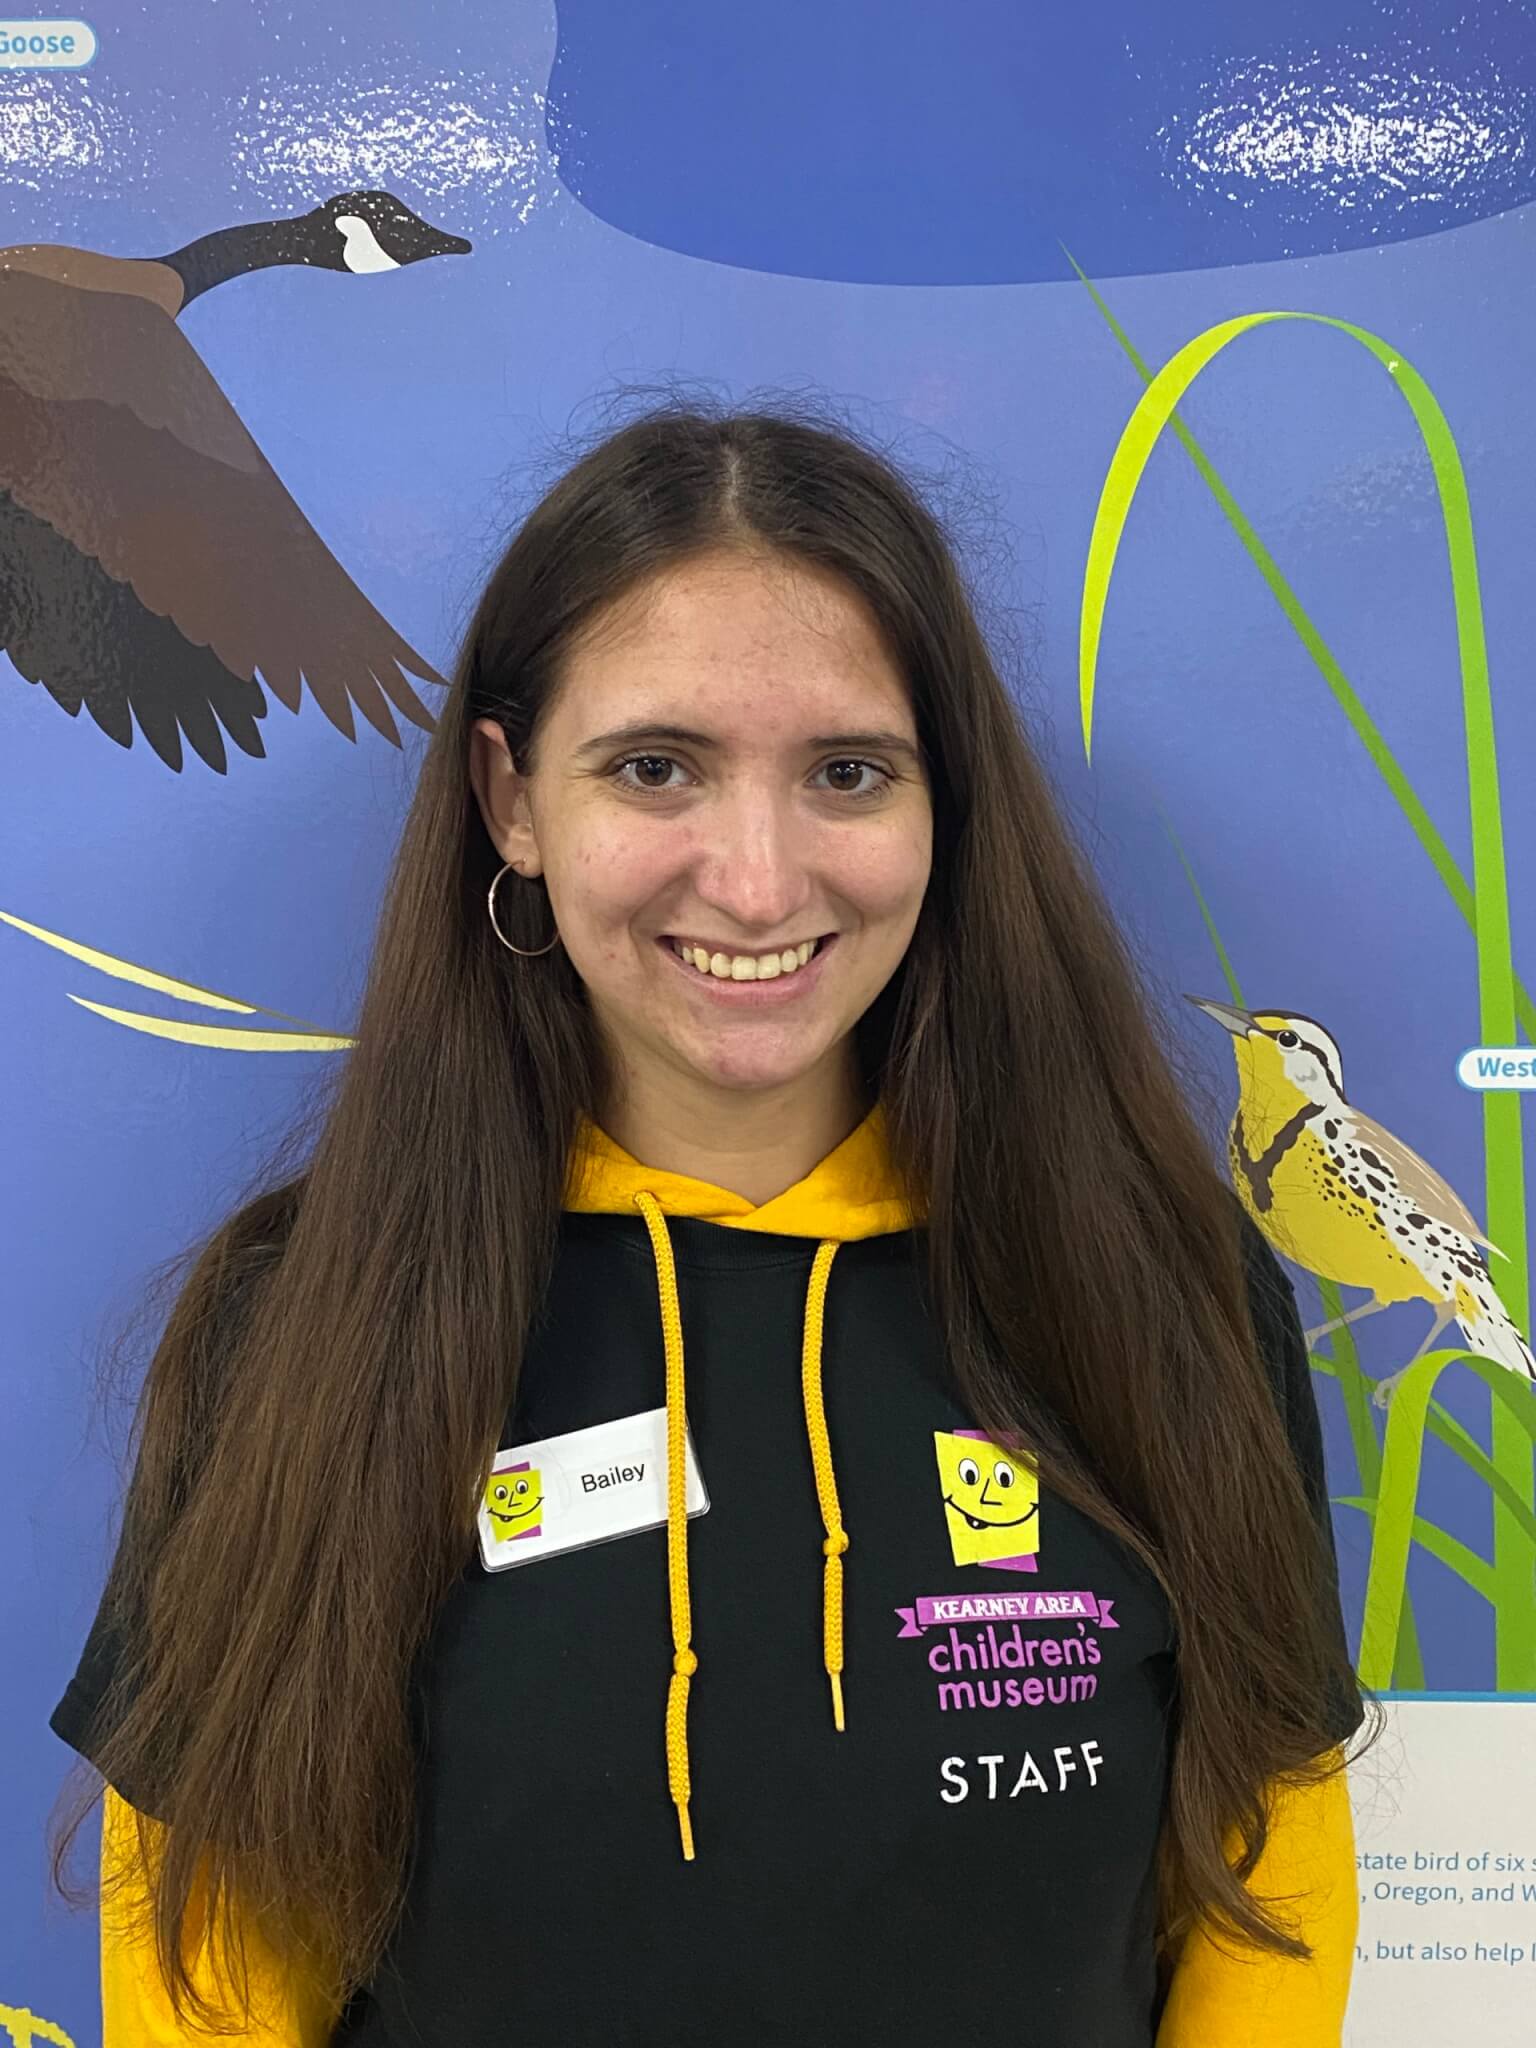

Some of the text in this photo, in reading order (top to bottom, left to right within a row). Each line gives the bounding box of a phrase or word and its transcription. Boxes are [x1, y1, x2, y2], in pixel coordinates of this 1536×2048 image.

[581, 1463, 645, 1493] Bailey
[932, 1596, 1087, 1620] KEARNEY AREA
[928, 1622, 1101, 1673] children's
[938, 1674, 1098, 1711] museum
[940, 1740, 1104, 1804] STAFF
[1414, 1851, 1459, 1870] bird
[1466, 1851, 1490, 1871] of
[1495, 1852, 1525, 1872] six
[1374, 1881, 1464, 1905] Oregon,
[1471, 1882, 1514, 1902] and
[1376, 1940, 1414, 1960] but
[1421, 1941, 1467, 1960] also
[1475, 1942, 1524, 1966] help
